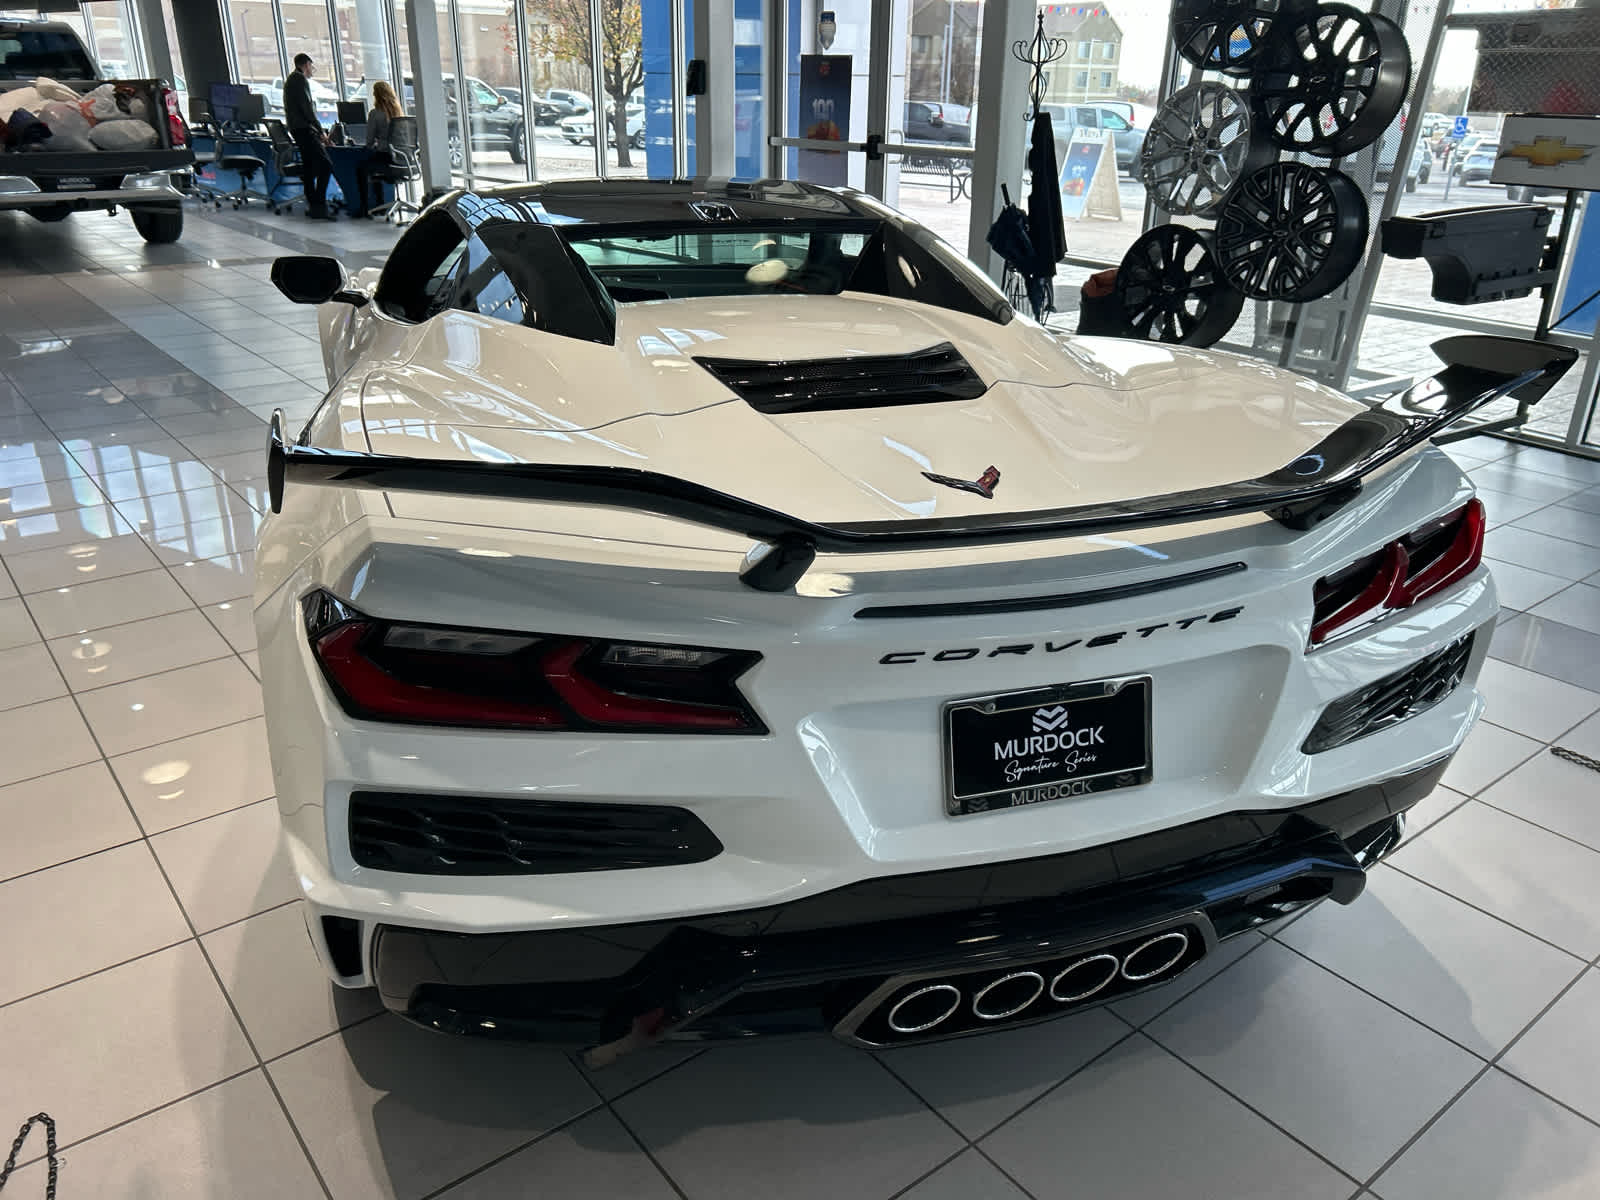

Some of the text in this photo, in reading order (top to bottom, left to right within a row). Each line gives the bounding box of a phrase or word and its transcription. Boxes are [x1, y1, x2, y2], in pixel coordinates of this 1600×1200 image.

[879, 606, 1244, 664] CORVETTE
[994, 725, 1105, 761] MURDOCK
[1004, 750, 1097, 783] Signature Series
[1011, 779, 1094, 806] MURDOCK
